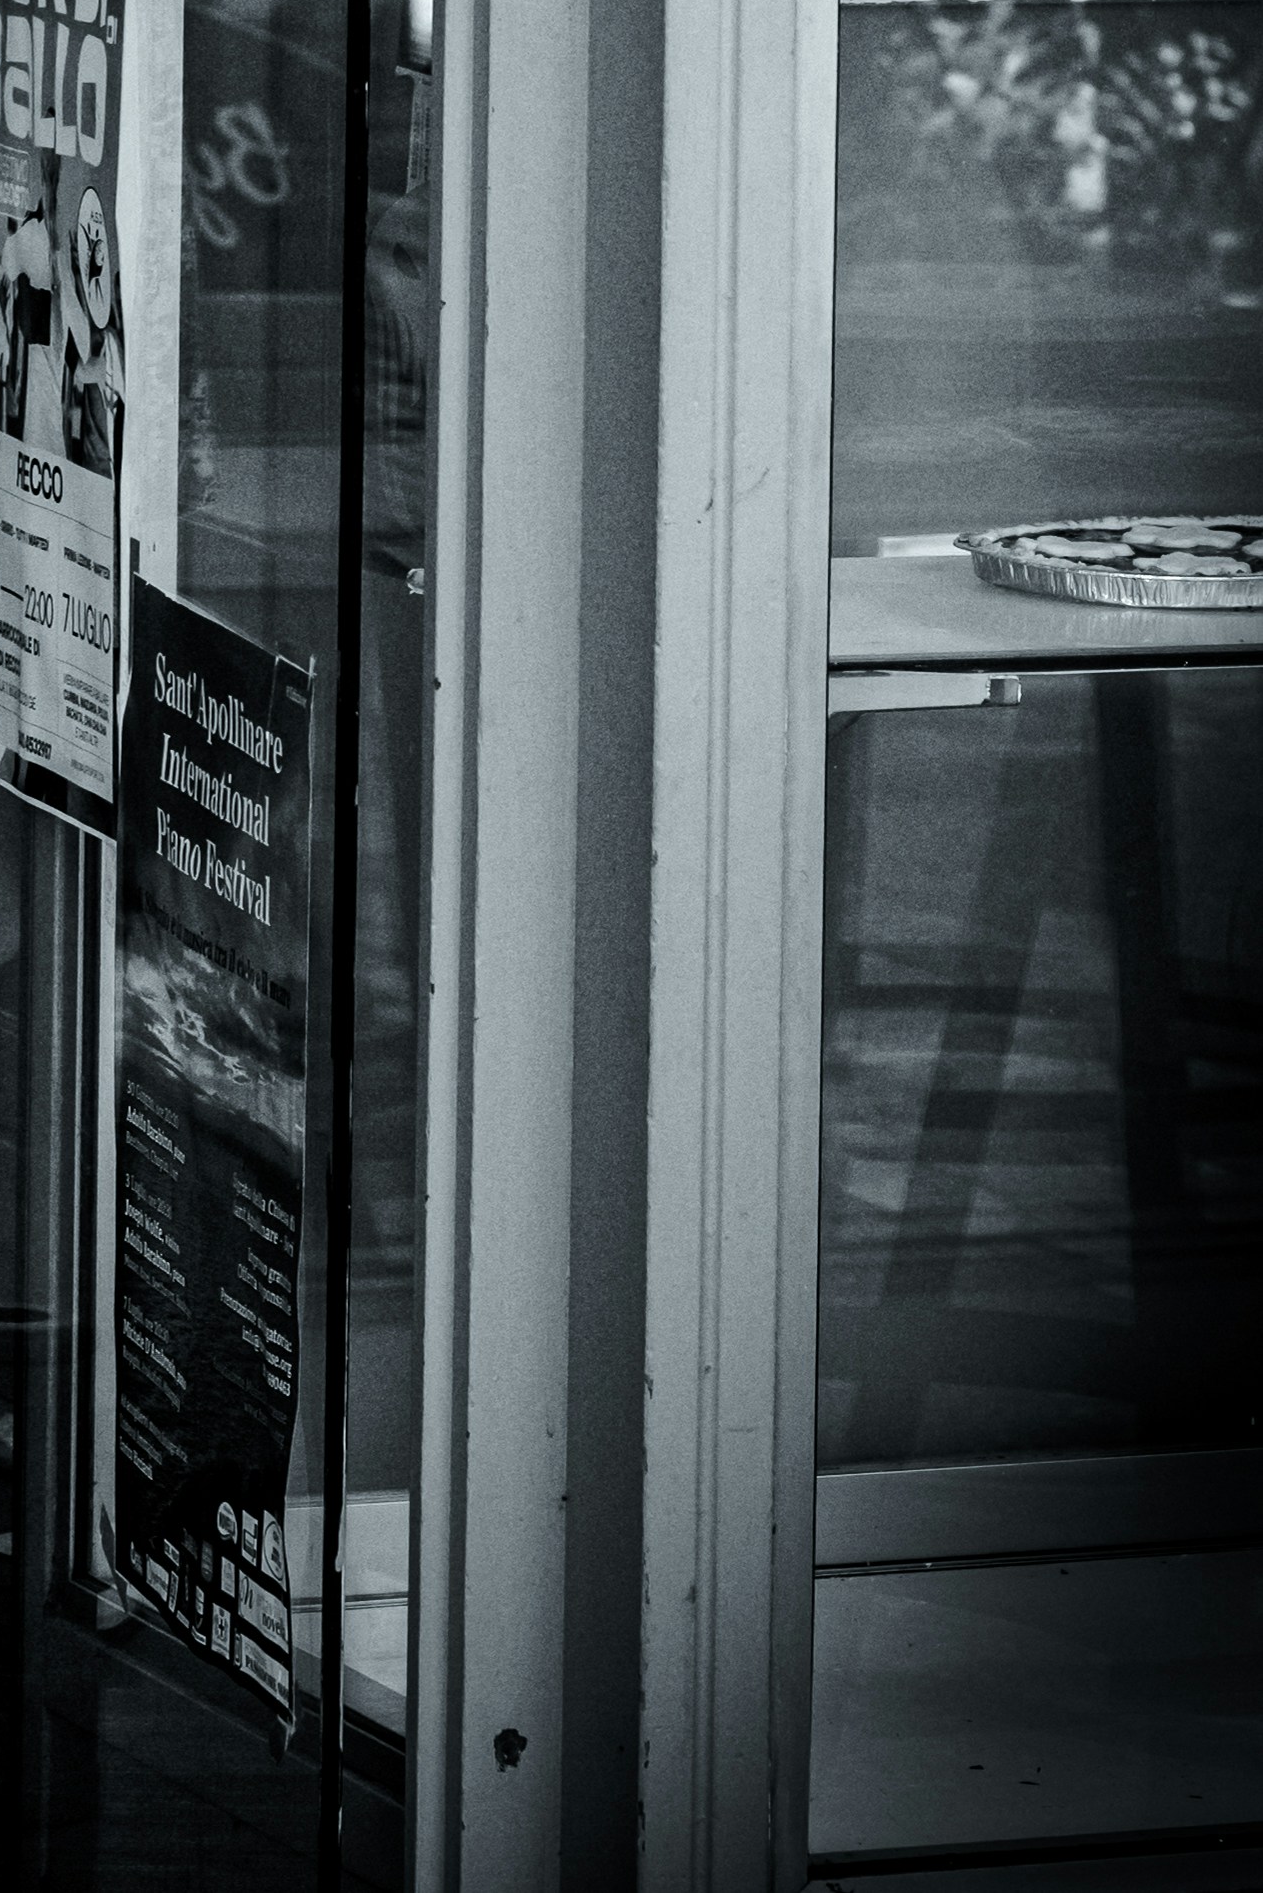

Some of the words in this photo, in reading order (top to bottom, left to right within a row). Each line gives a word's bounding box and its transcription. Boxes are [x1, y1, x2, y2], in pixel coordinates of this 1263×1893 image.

[16, 451, 64, 504] RECCO
[24, 583, 54, 630] 22:00
[62, 592, 71, 632] 7
[71, 596, 111, 654] LUGLIO
[160, 732, 269, 847] International
[156, 806, 201, 882] Piano
[205, 838, 271, 927] Festival
[126, 1102, 145, 1133] Adolfo
[124, 1196, 143, 1231] Joseph
[124, 1223, 142, 1254] Adolfo
